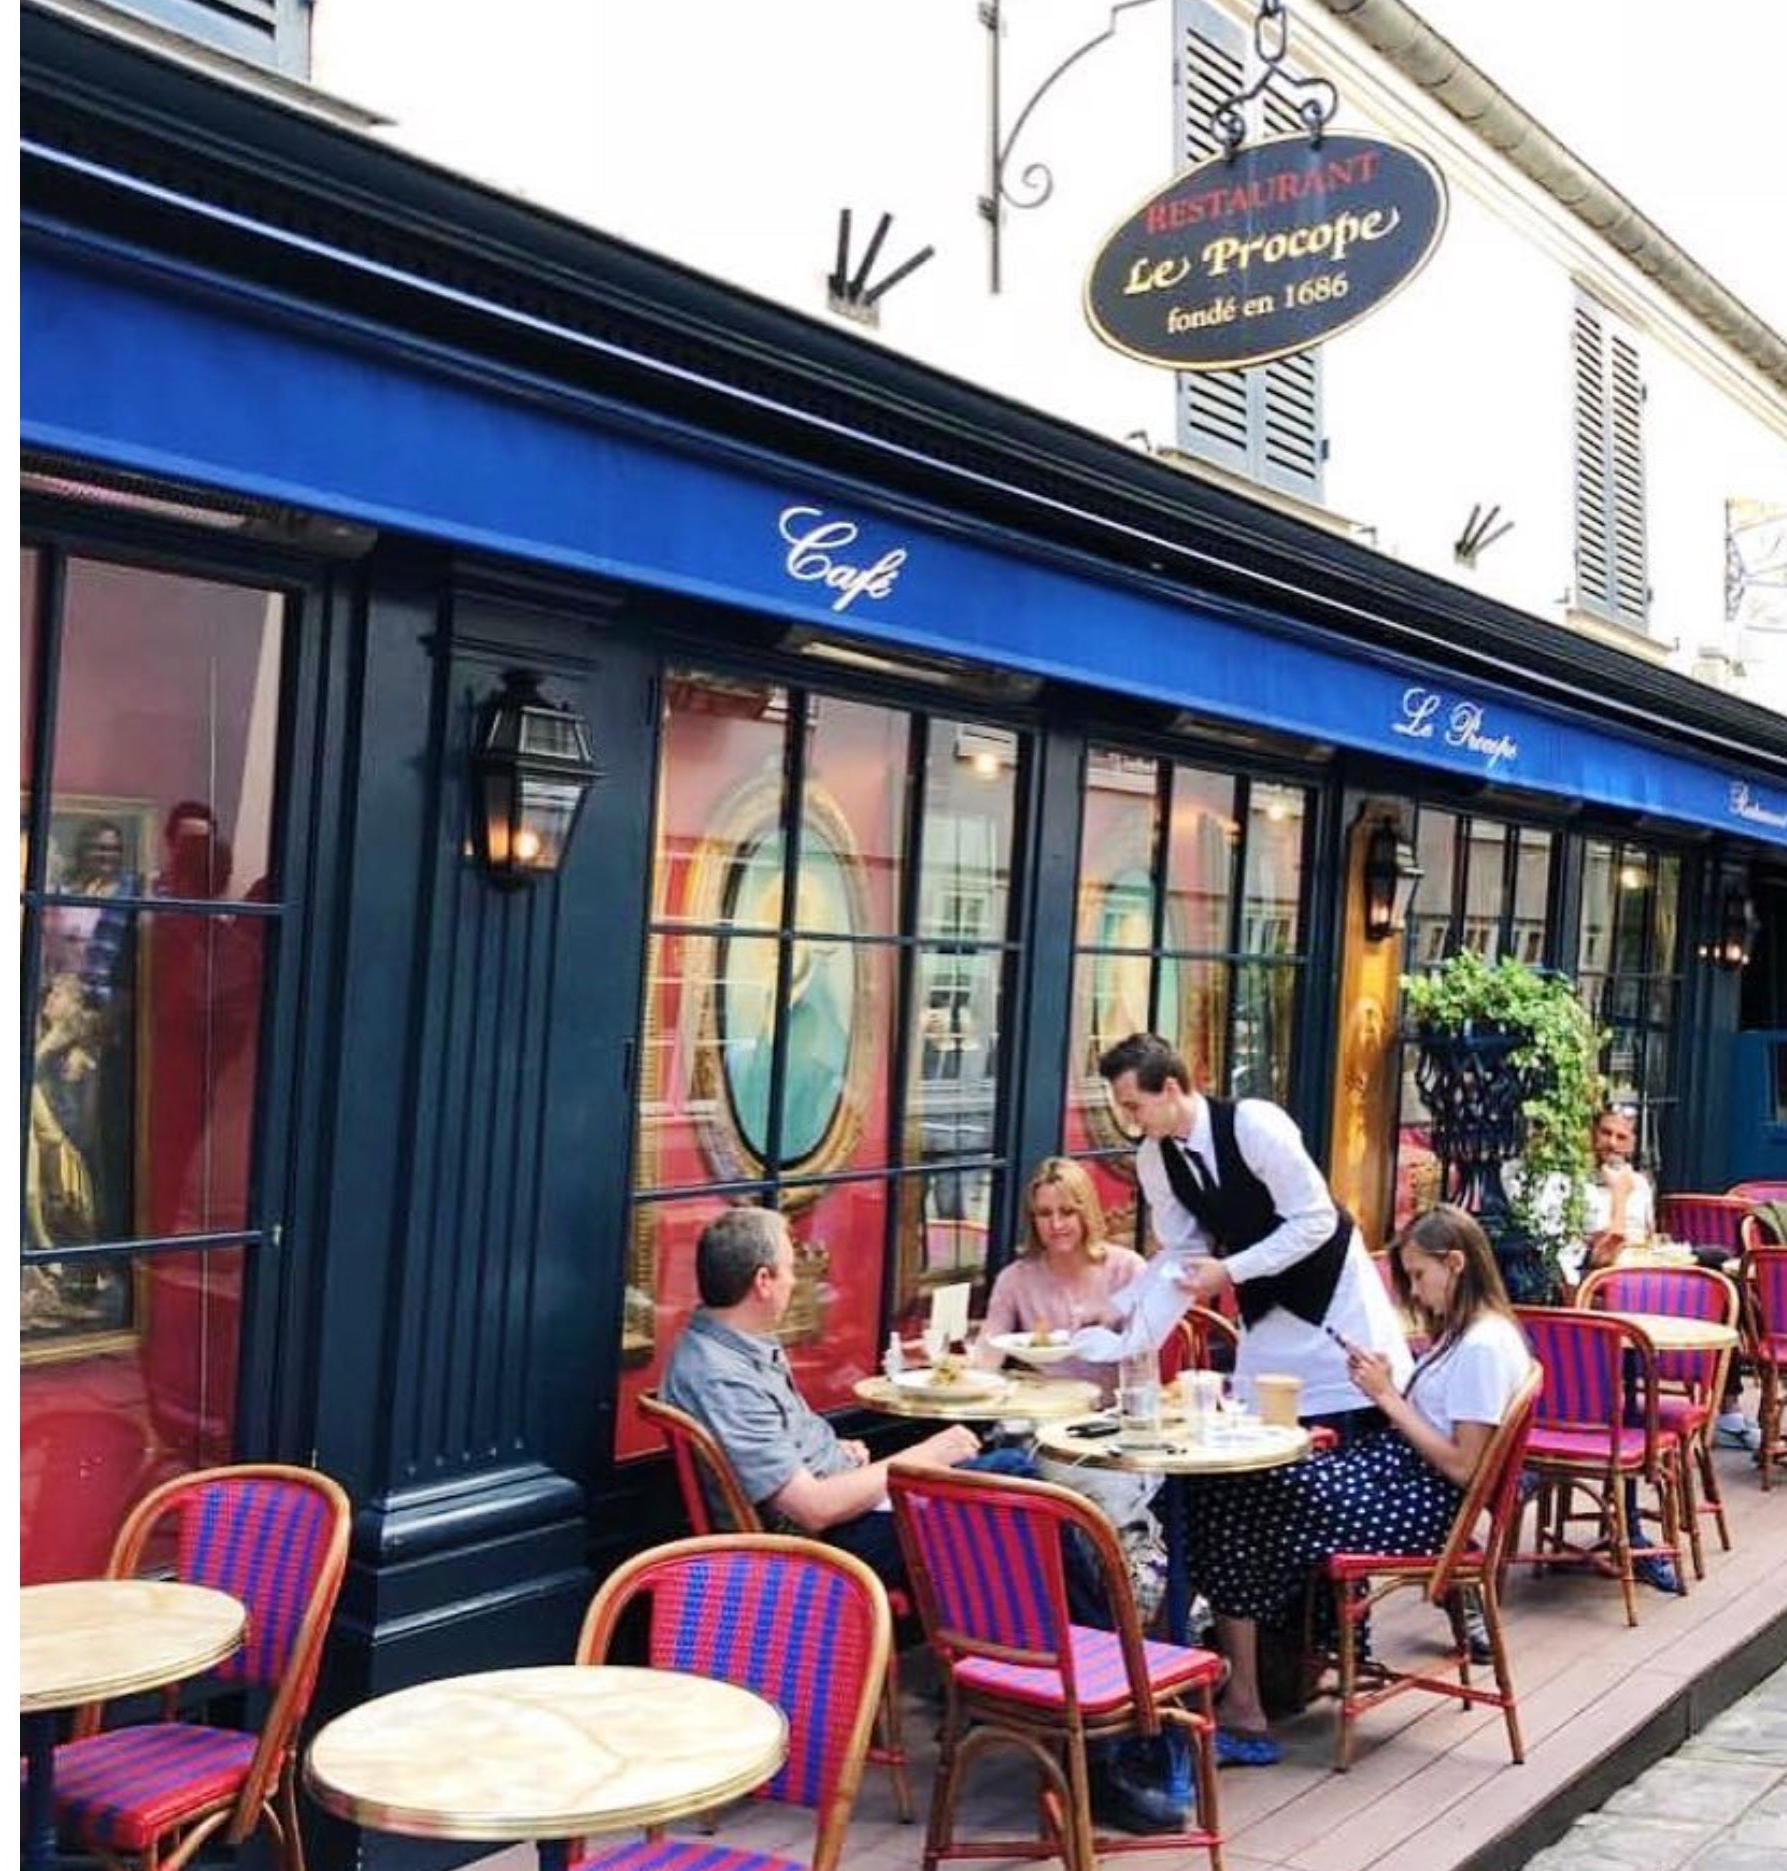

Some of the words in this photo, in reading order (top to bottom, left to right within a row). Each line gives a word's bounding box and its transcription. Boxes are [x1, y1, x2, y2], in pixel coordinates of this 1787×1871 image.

[1146, 152, 1379, 233] RESTAURANT
[1124, 257, 1192, 295] Le
[1202, 205, 1400, 277] Procope
[1166, 298, 1238, 334] fondé
[1243, 294, 1274, 316] en
[1284, 272, 1349, 308] 1686
[779, 505, 907, 611] Café
